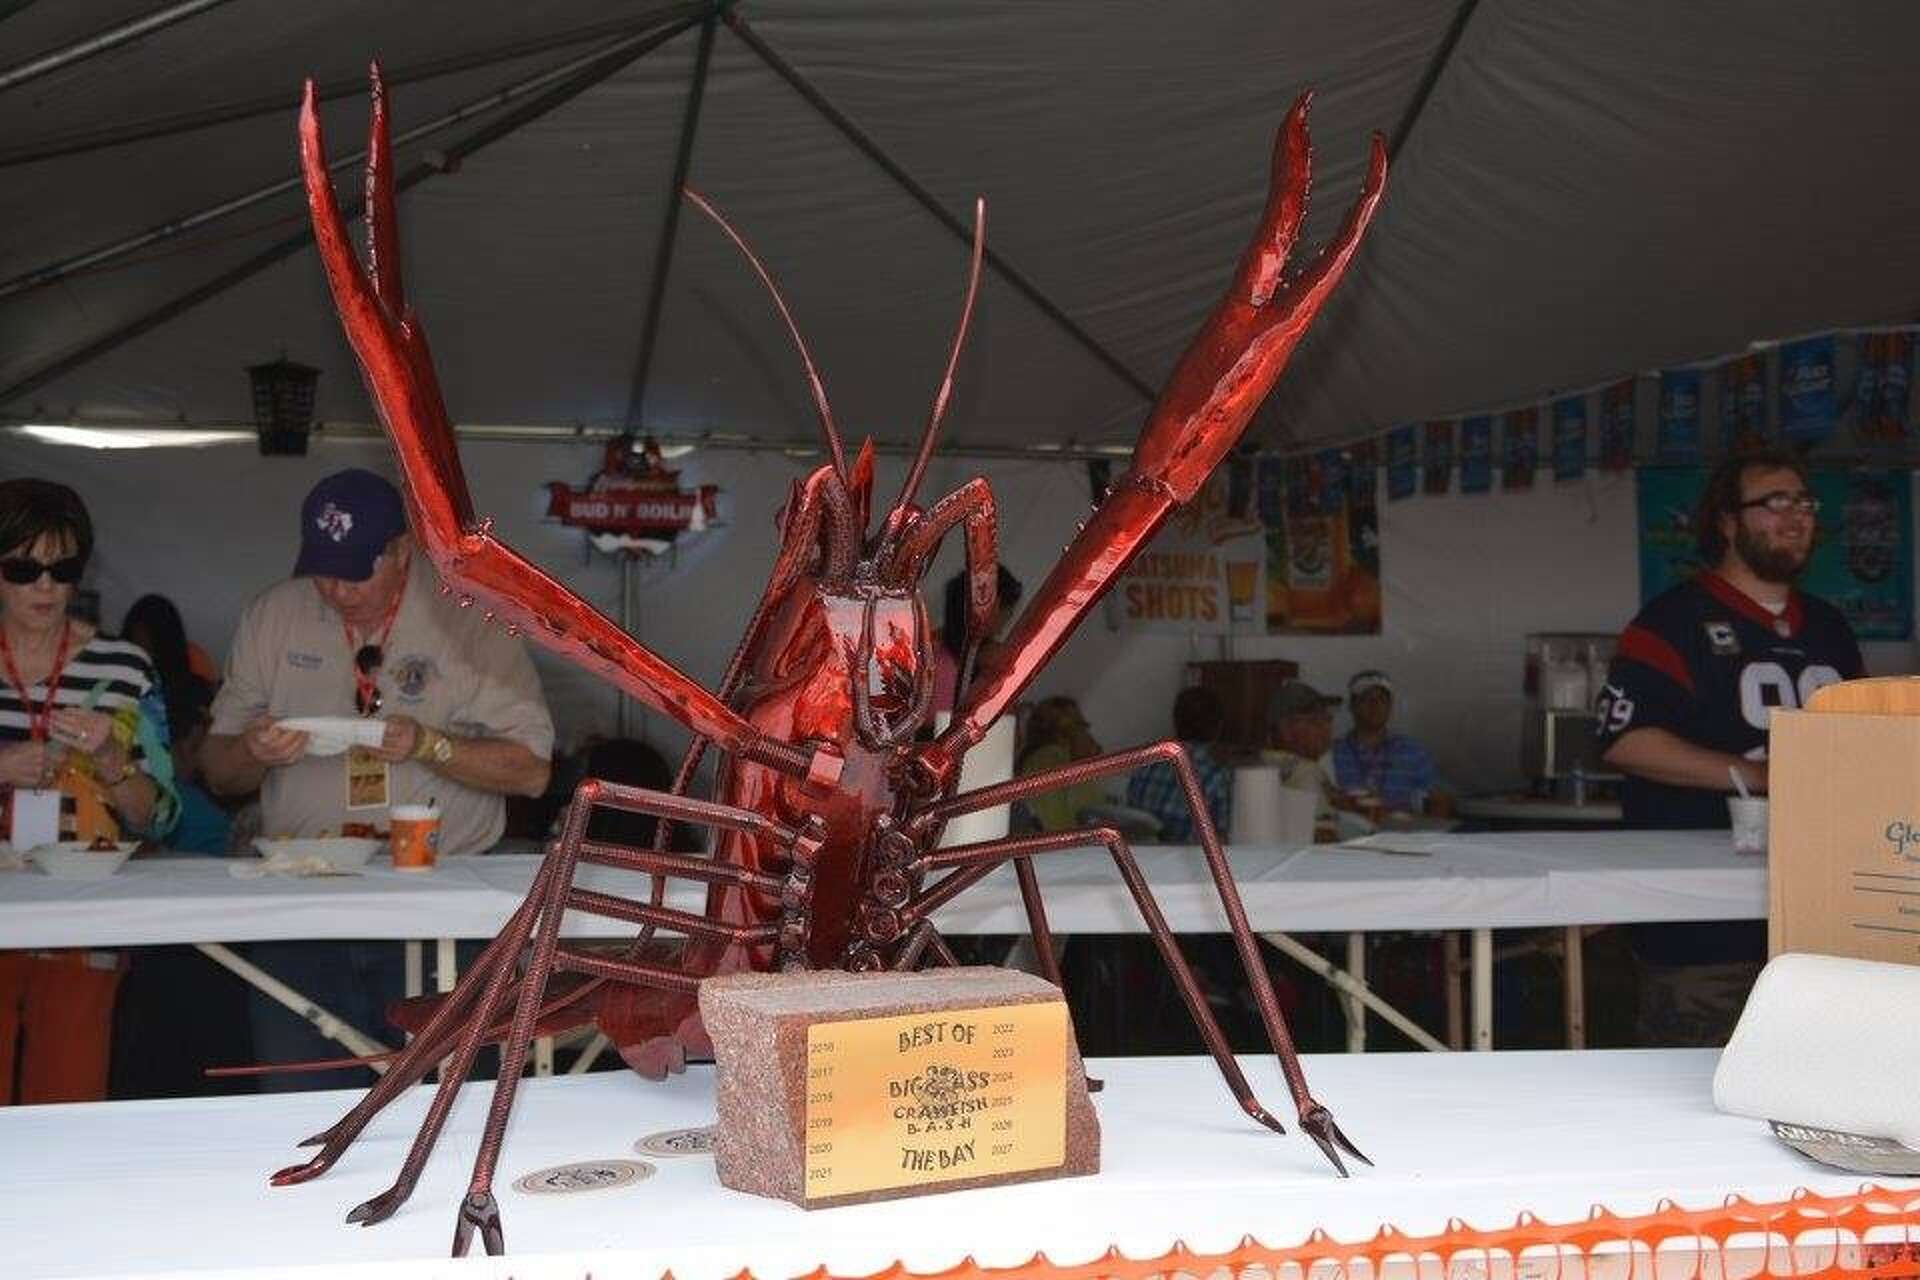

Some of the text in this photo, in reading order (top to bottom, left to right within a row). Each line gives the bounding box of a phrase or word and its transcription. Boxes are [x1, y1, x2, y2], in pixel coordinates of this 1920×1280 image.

[1133, 553, 1218, 577] ATSUMA
[1125, 583, 1218, 622] SHOTS
[898, 1022, 976, 1053] BEST OF
[893, 1096, 990, 1120] CRAWFISH
[901, 1139, 976, 1171] THE BAY
